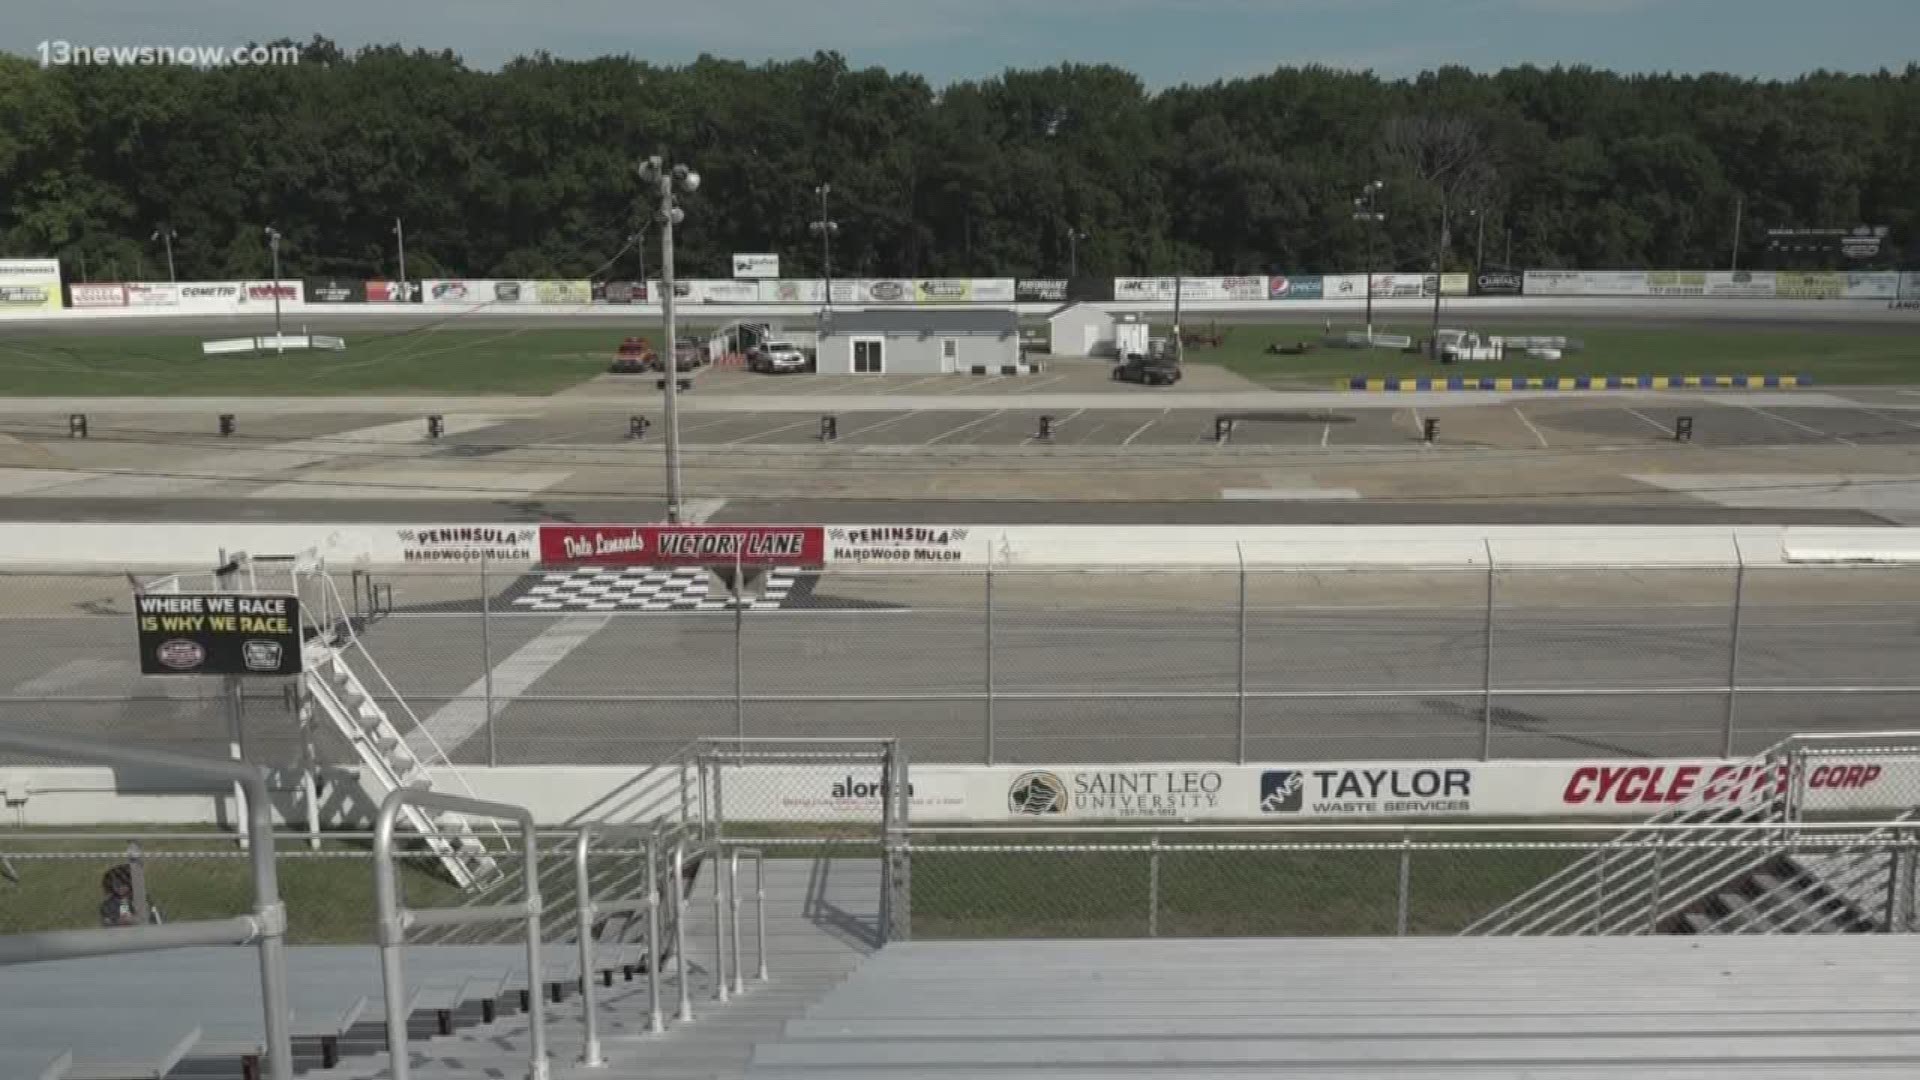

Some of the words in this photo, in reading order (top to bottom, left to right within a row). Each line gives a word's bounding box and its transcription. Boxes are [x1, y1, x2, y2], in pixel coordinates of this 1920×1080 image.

[417, 527, 518, 545] PENINSULA
[658, 532, 745, 558] VICTORY
[747, 532, 804, 555] LANE
[848, 527, 950, 545] PENINSULA
[404, 548, 481, 561] HARDWOOD
[485, 548, 530, 560] MULCH
[564, 535, 593, 558] Dale
[833, 548, 910, 561] HARDWOOD
[913, 548, 962, 560] MULCH
[140, 598, 203, 613] WHERE
[206, 598, 235, 613] WE
[239, 599, 286, 614] RACE
[141, 616, 158, 631] IS
[161, 616, 205, 631] WHY
[208, 616, 238, 632] WE
[240, 617, 293, 634] RACE.
[831, 775, 914, 798] alor
[1074, 772, 1159, 794] SAINT
[1167, 771, 1223, 794] LEO
[1312, 768, 1472, 799] TAYLOR
[1562, 766, 1703, 804] CYCLE
[1808, 765, 1883, 788] CORP
[1074, 794, 1218, 809] UNIVERSITY
[1312, 801, 1377, 813] WASTE
[1383, 800, 1471, 812] SERVICES
